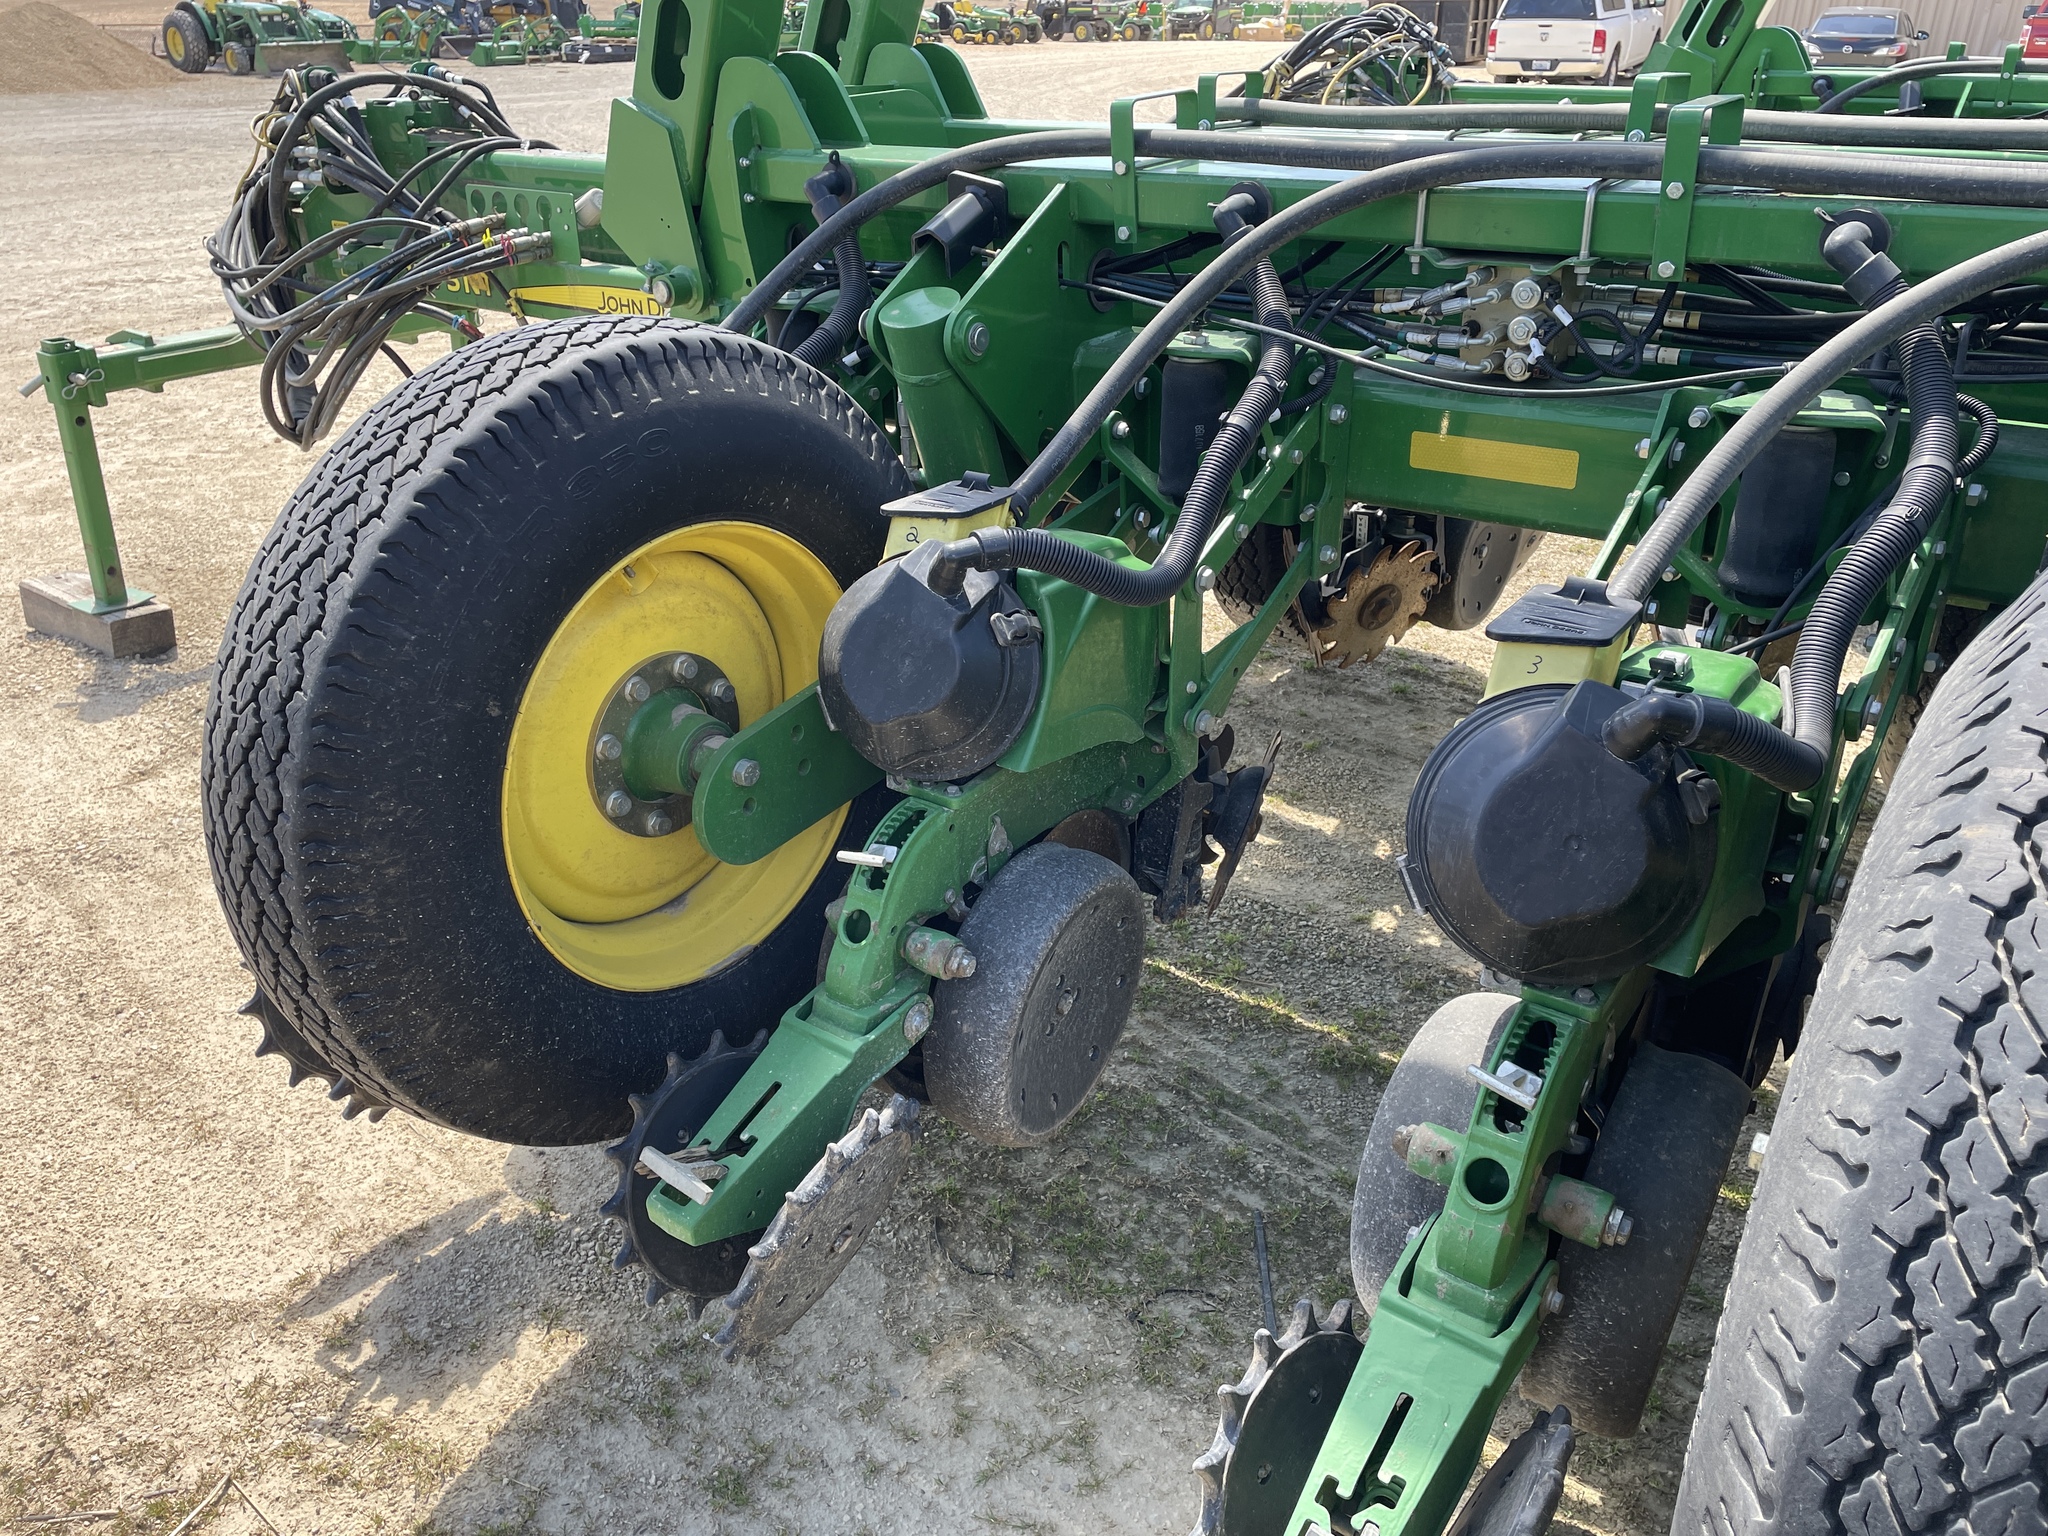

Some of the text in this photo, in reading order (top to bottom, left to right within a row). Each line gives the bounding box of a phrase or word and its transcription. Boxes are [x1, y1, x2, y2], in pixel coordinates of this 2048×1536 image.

[598, 291, 665, 315] JOHN D
[905, 526, 920, 544] 2
[1527, 655, 1543, 674] 3
